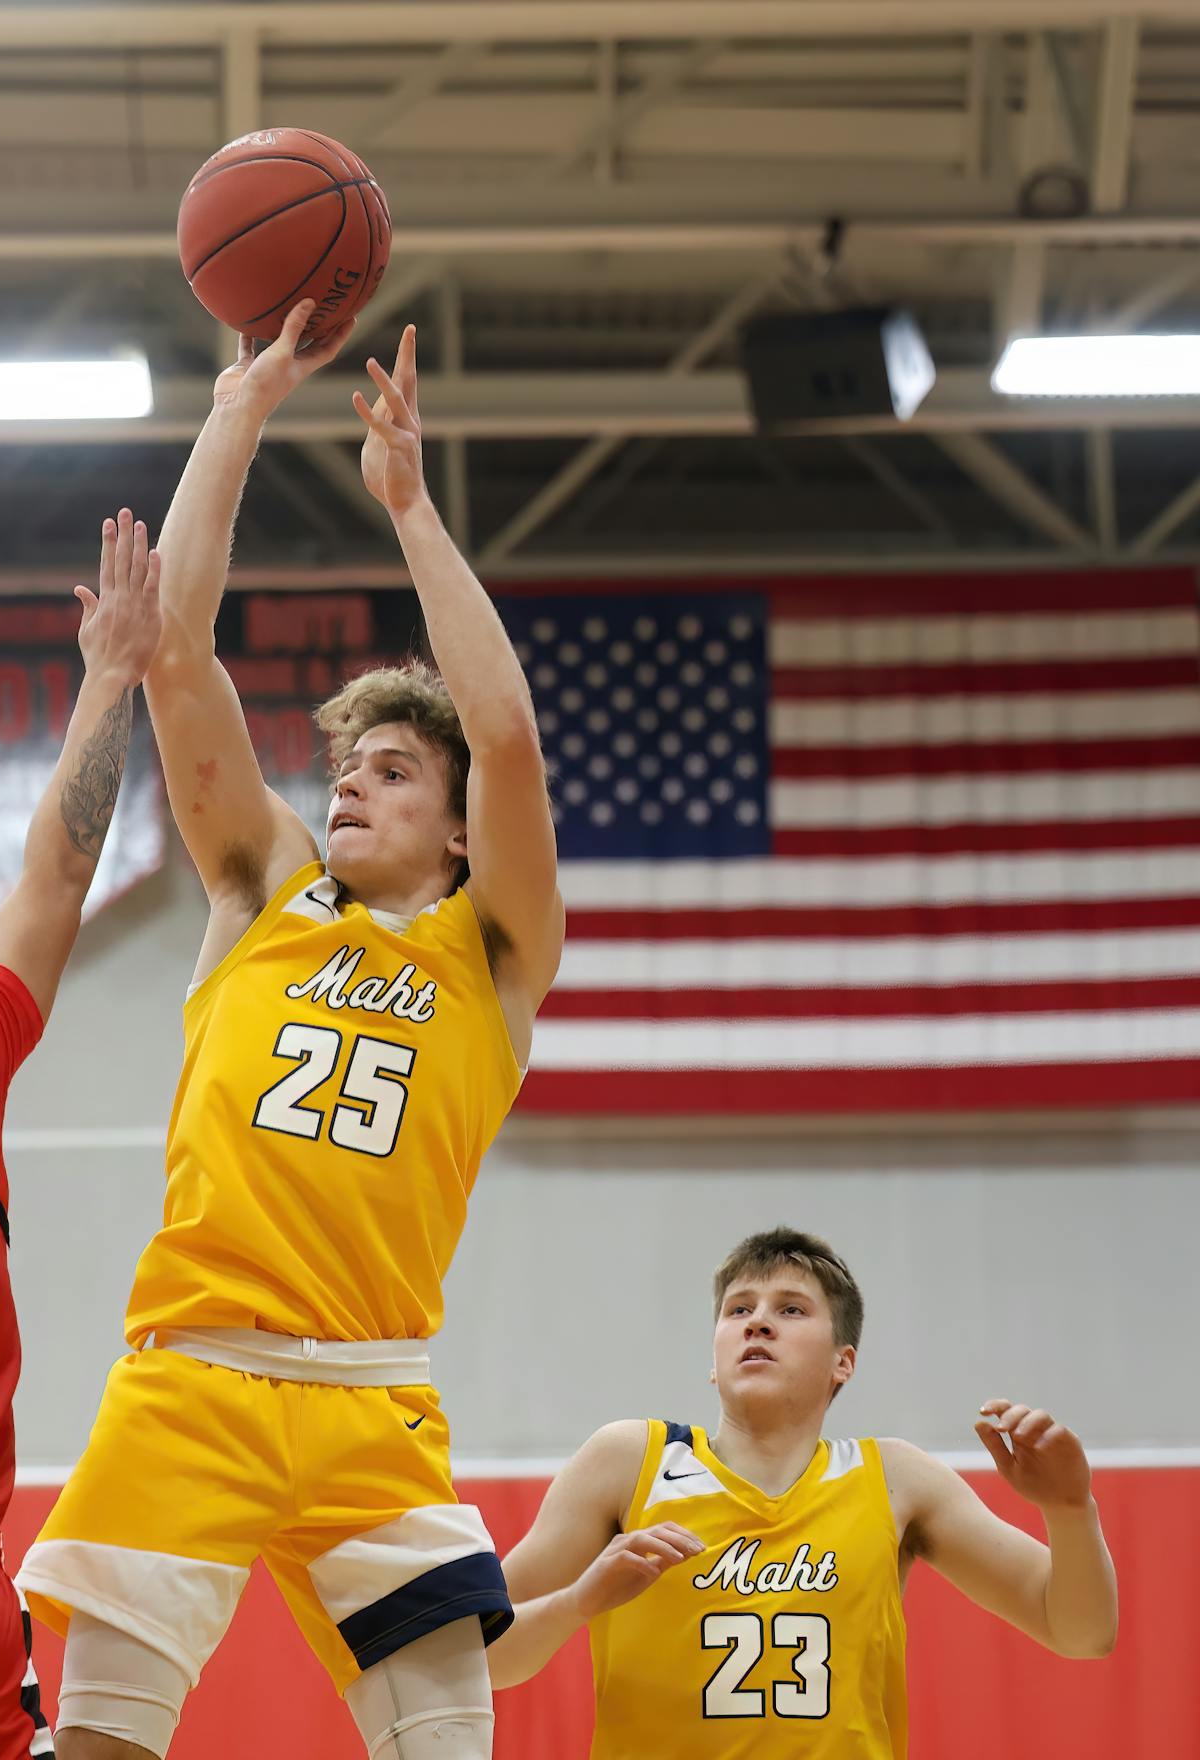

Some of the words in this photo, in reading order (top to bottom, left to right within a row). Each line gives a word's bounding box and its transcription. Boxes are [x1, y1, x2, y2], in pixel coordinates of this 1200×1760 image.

[285, 944, 438, 1024] Maht
[251, 1022, 418, 1158] 25
[692, 1536, 839, 1596] Maht
[700, 1612, 832, 1719] 23
